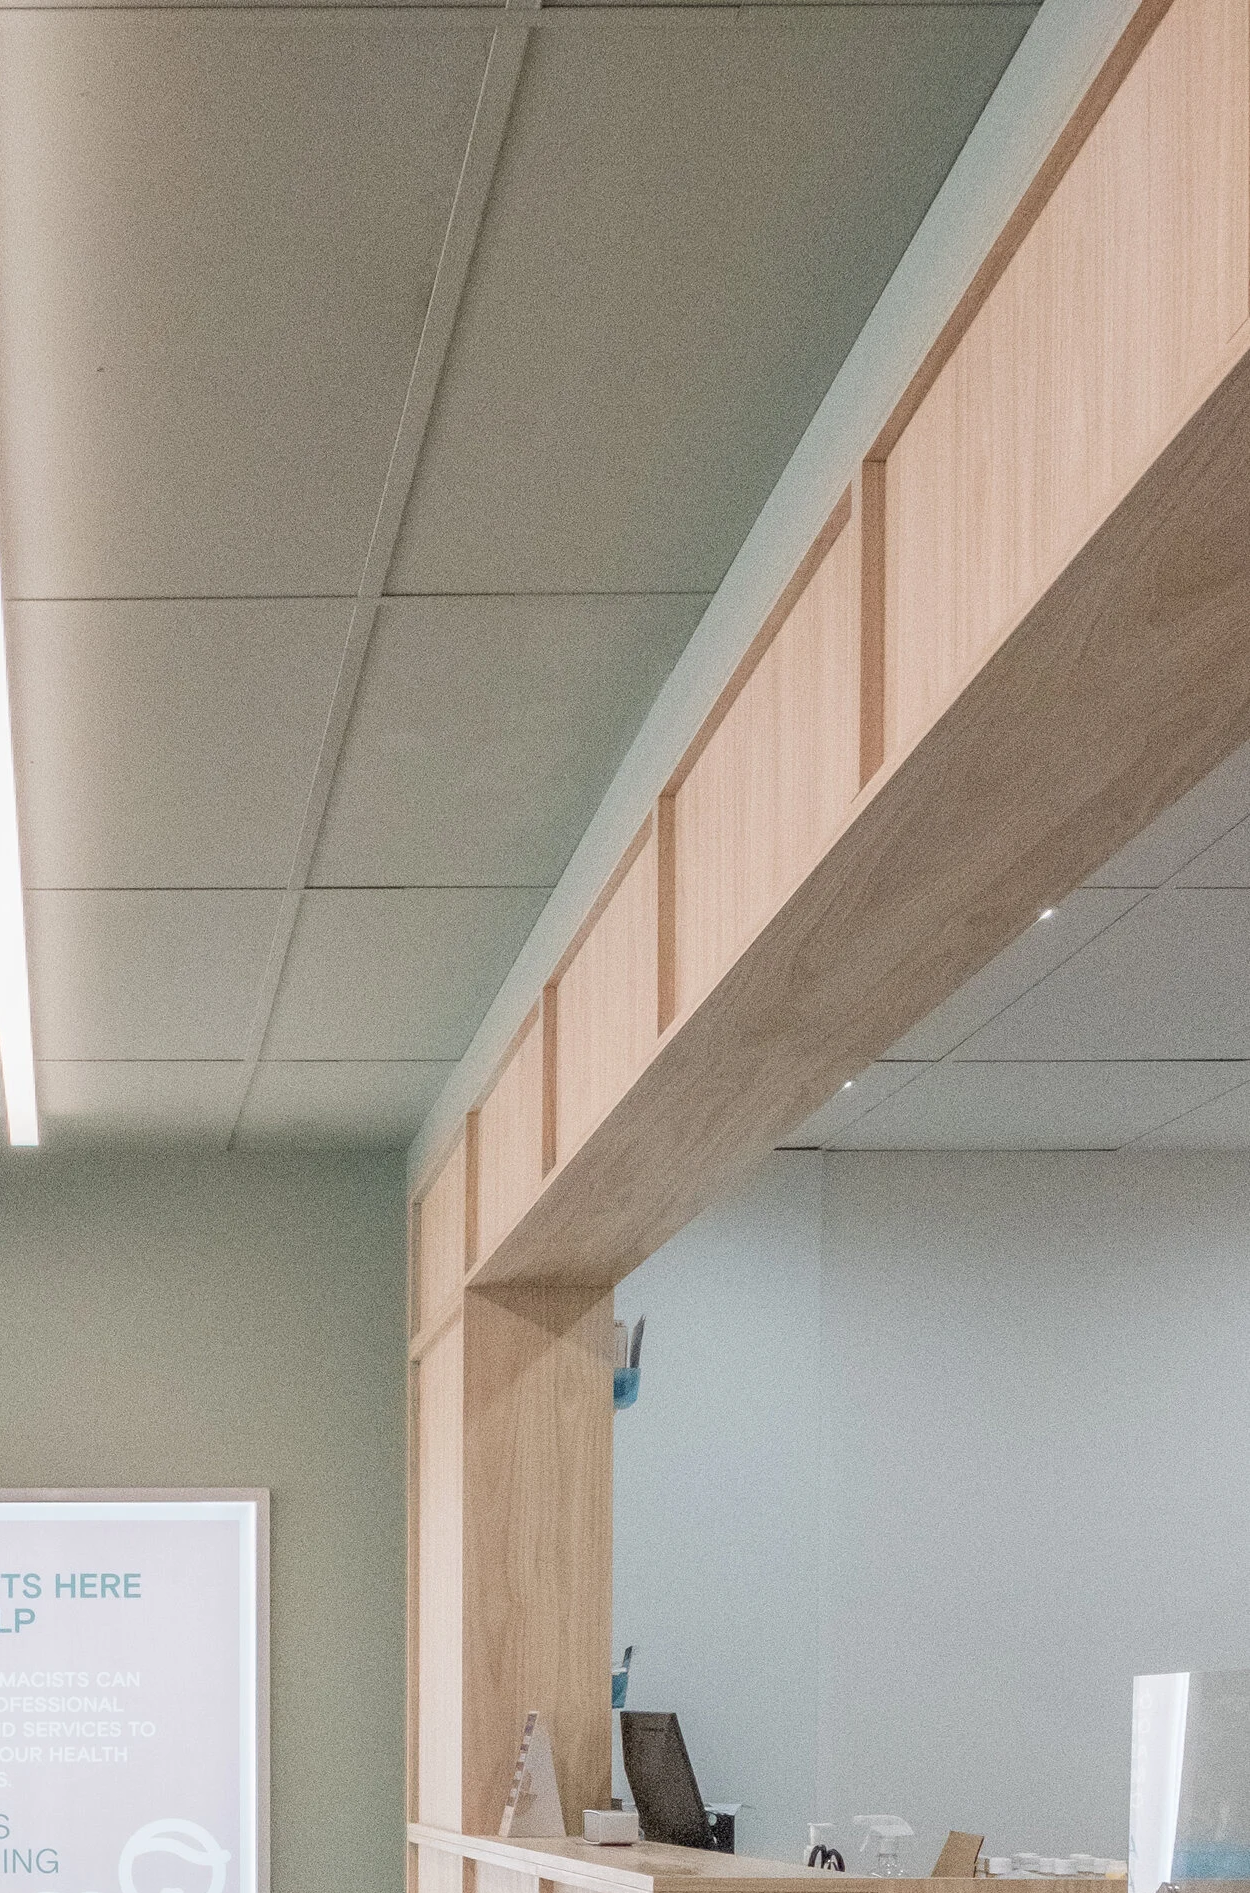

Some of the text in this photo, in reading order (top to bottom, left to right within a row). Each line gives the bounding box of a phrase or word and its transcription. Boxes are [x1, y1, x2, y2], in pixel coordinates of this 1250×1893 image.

[55, 1573, 141, 1598] HERE
[97, 1672, 140, 1687] CAN
[24, 1722, 121, 1737] SERVICES
[128, 1721, 155, 1737] TO
[50, 1746, 127, 1762] HEALTH
